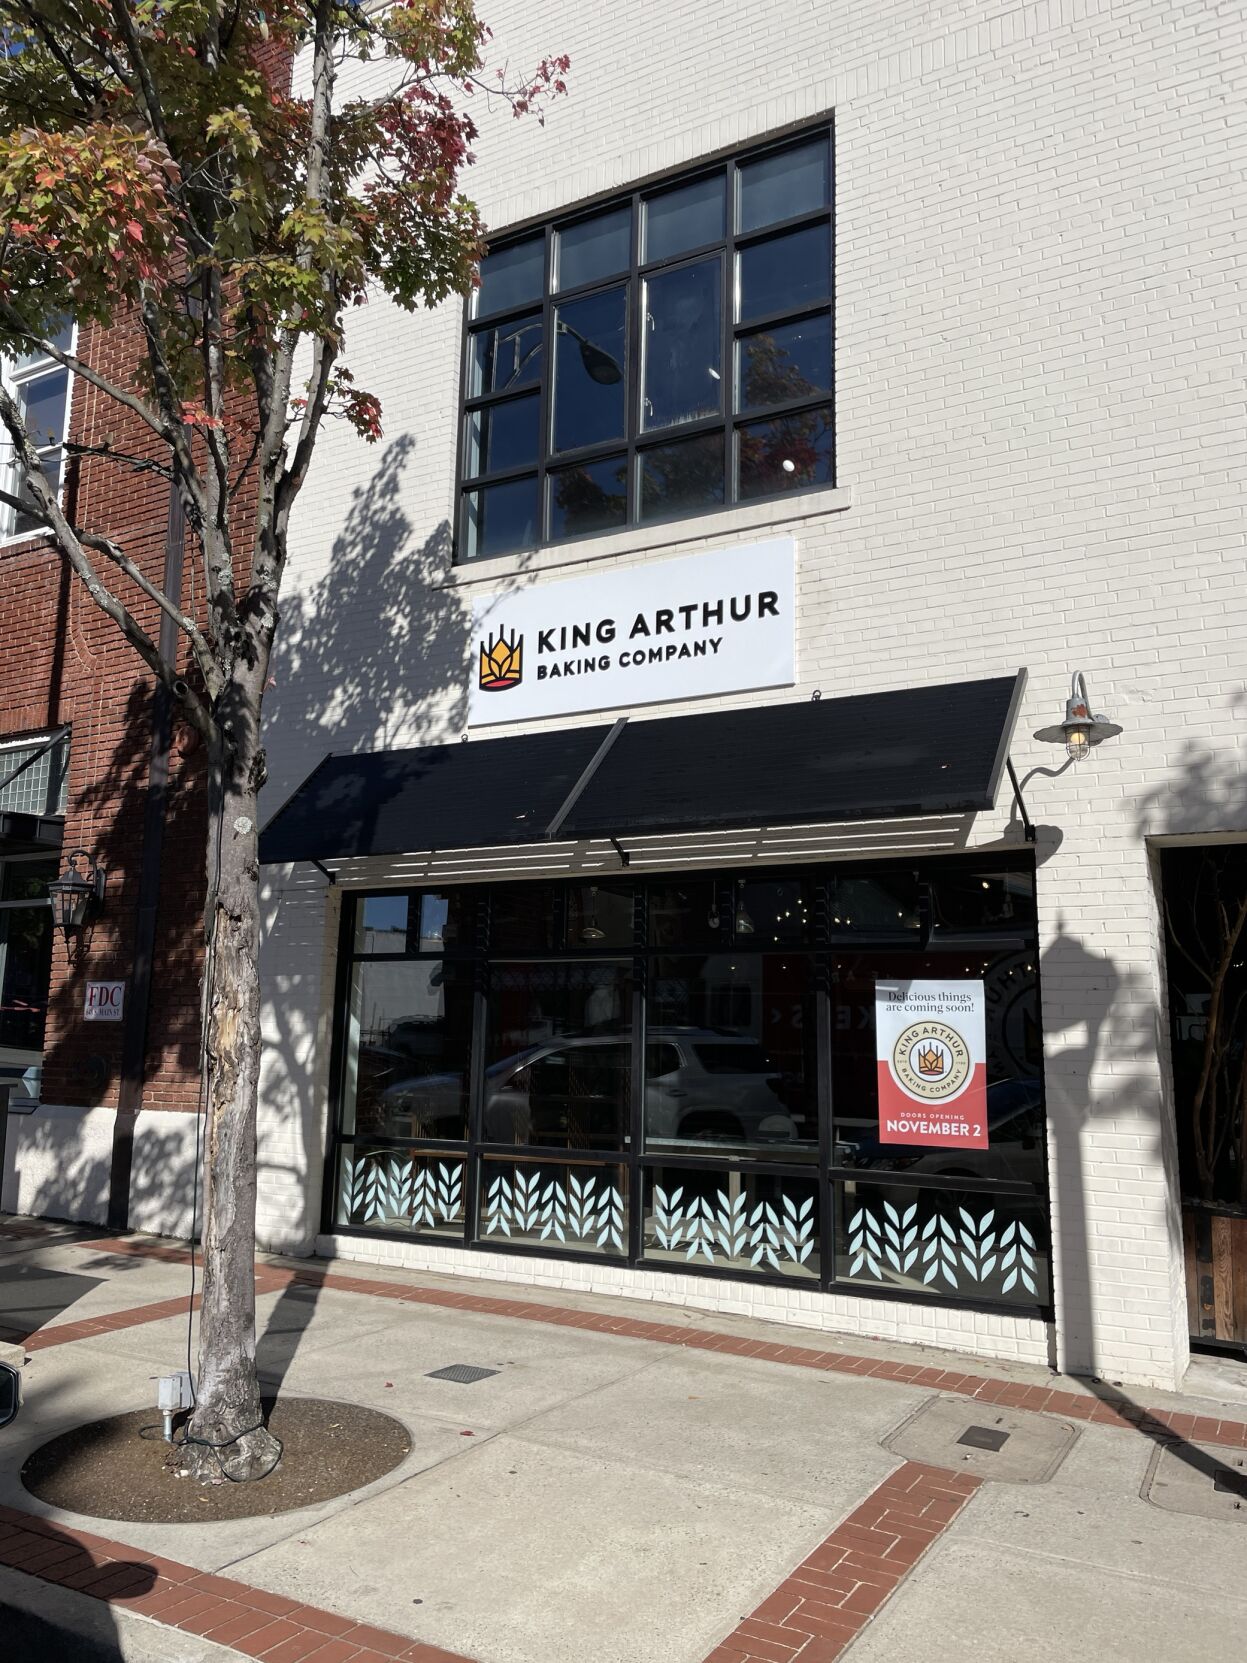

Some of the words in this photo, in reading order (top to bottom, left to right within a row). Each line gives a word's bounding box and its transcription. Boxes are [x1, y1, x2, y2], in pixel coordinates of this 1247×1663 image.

[537, 618, 616, 655] KING
[629, 590, 781, 639] ARTHUR
[537, 654, 611, 681] BAKING
[619, 637, 723, 668] COMPANY
[88, 986, 122, 1007] FDC
[888, 991, 936, 1002] Delicious
[938, 991, 972, 1004] things
[886, 1003, 902, 1012] are
[904, 1003, 944, 1014] coming
[945, 1002, 975, 1012] soon!
[899, 1030, 920, 1056] KING
[922, 1026, 964, 1057] ARTHUR
[902, 1068, 927, 1092] BAKING
[929, 1070, 962, 1093] COMPANY
[929, 1113, 965, 1121] OPENING
[886, 1119, 970, 1137] NOVEMBER
[972, 1124, 981, 1137] 2
